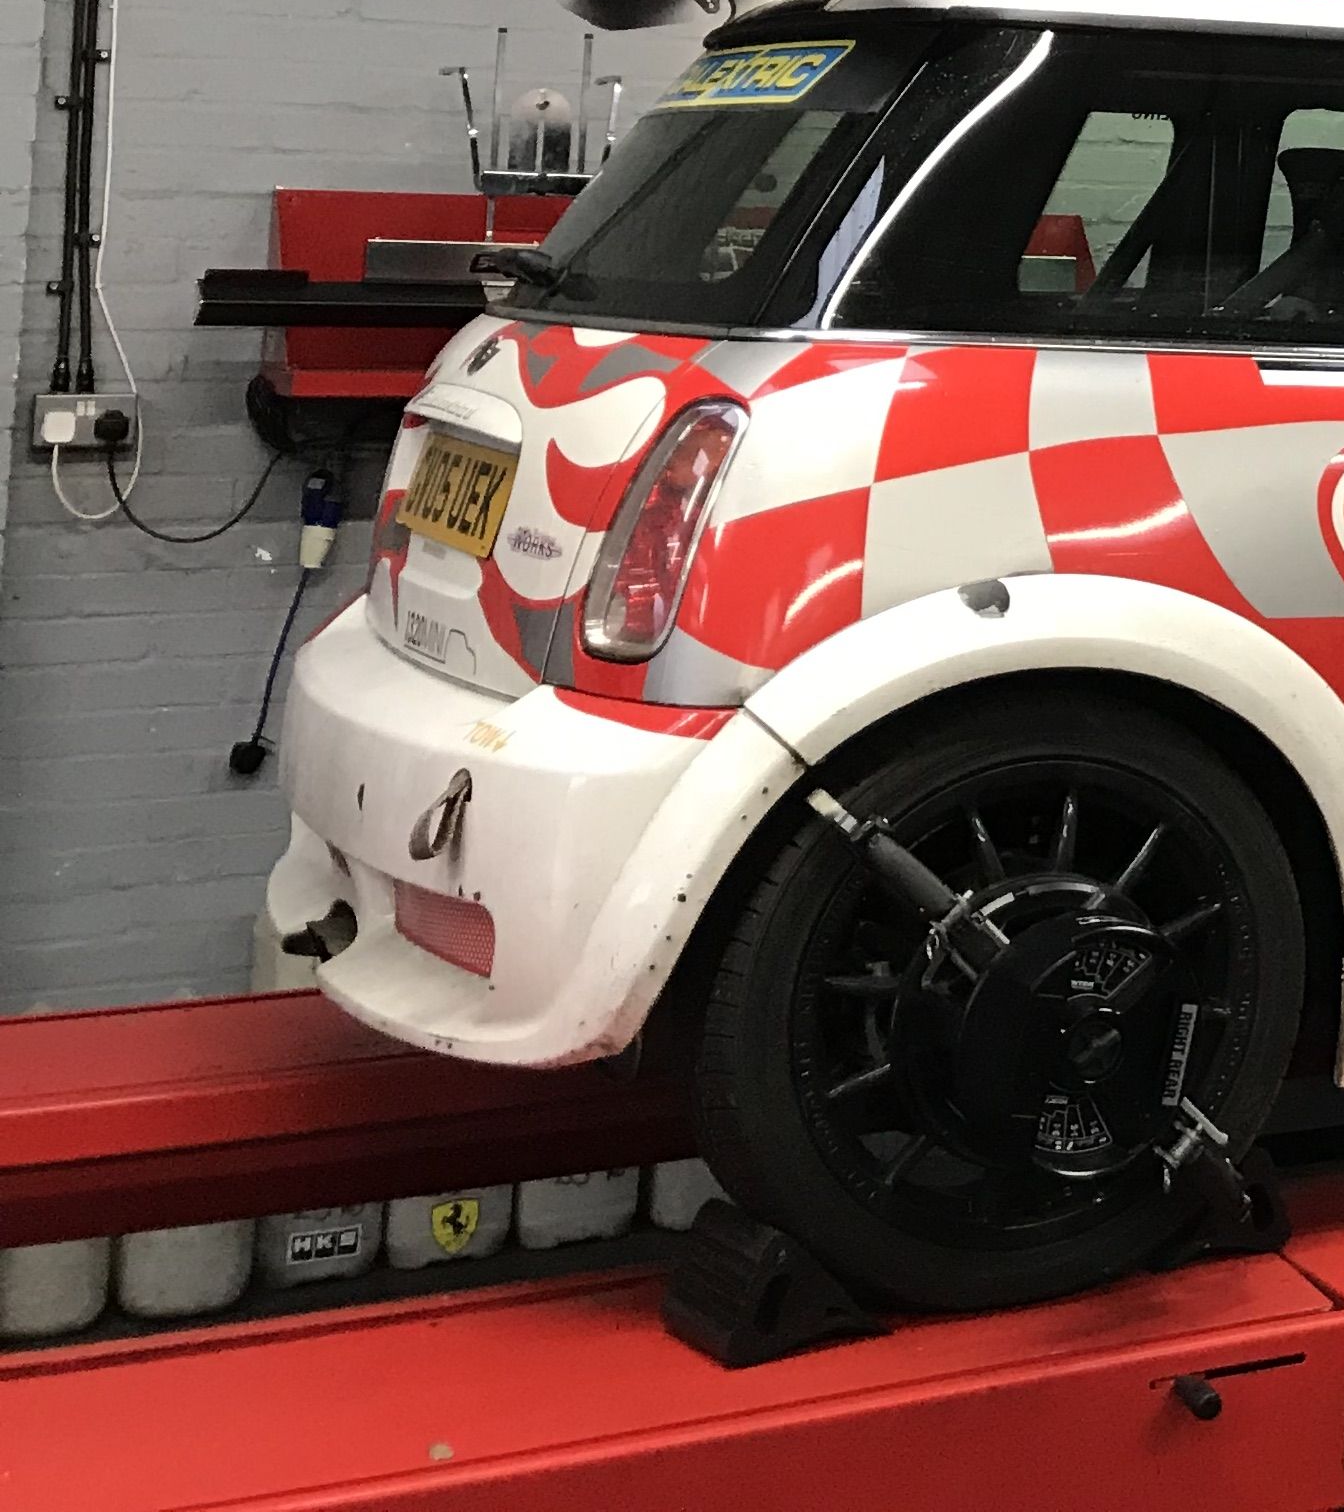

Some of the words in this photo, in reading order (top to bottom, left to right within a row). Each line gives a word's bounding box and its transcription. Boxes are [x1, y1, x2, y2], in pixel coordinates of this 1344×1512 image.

[447, 457, 508, 541] UEK
[1172, 1011, 1193, 1055] RIGHT
[1163, 1058, 1184, 1100] REAR
